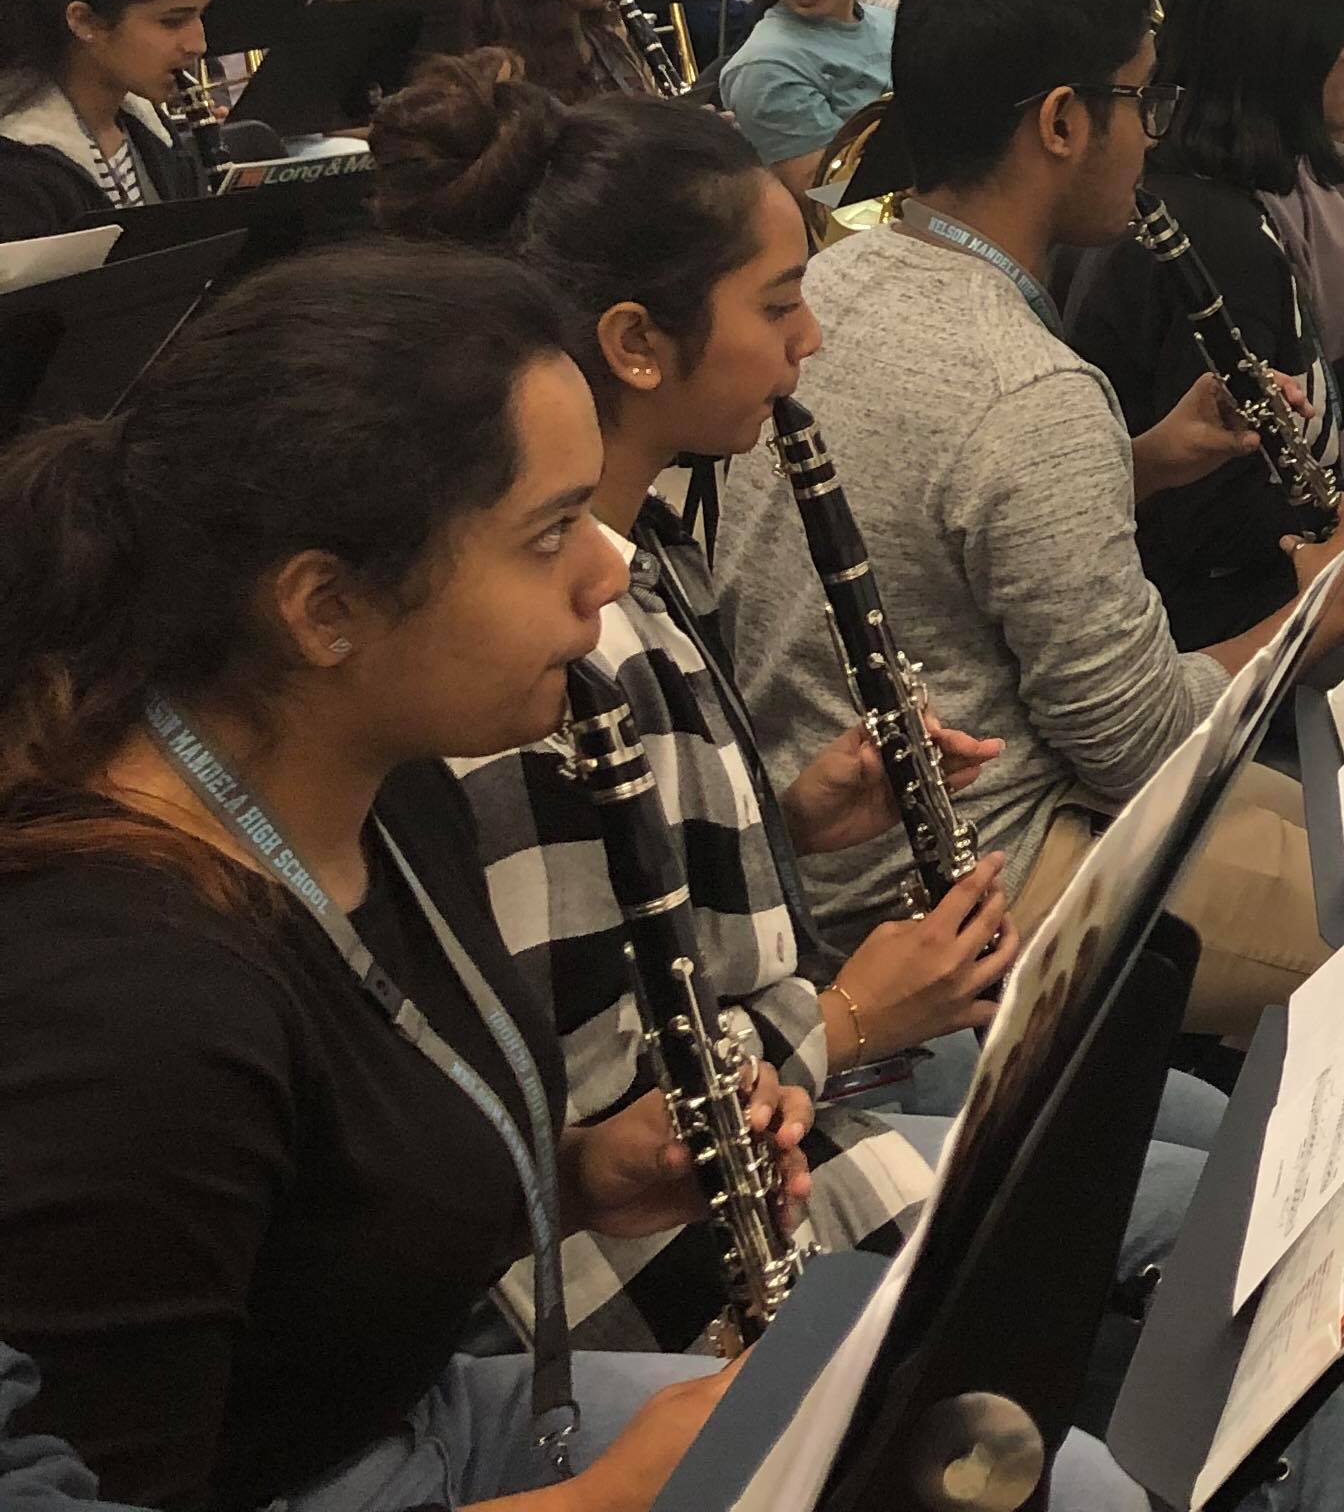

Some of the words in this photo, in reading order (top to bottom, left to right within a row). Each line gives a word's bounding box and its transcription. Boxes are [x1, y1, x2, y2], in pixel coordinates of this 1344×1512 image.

[264, 164, 322, 184] Long
[324, 157, 339, 177] &
[928, 216, 971, 246] NELSON
[967, 237, 1021, 280] MANDELA
[168, 727, 249, 814] MANDELA
[236, 805, 283, 855] HIGH
[272, 848, 329, 915] SCHOOL
